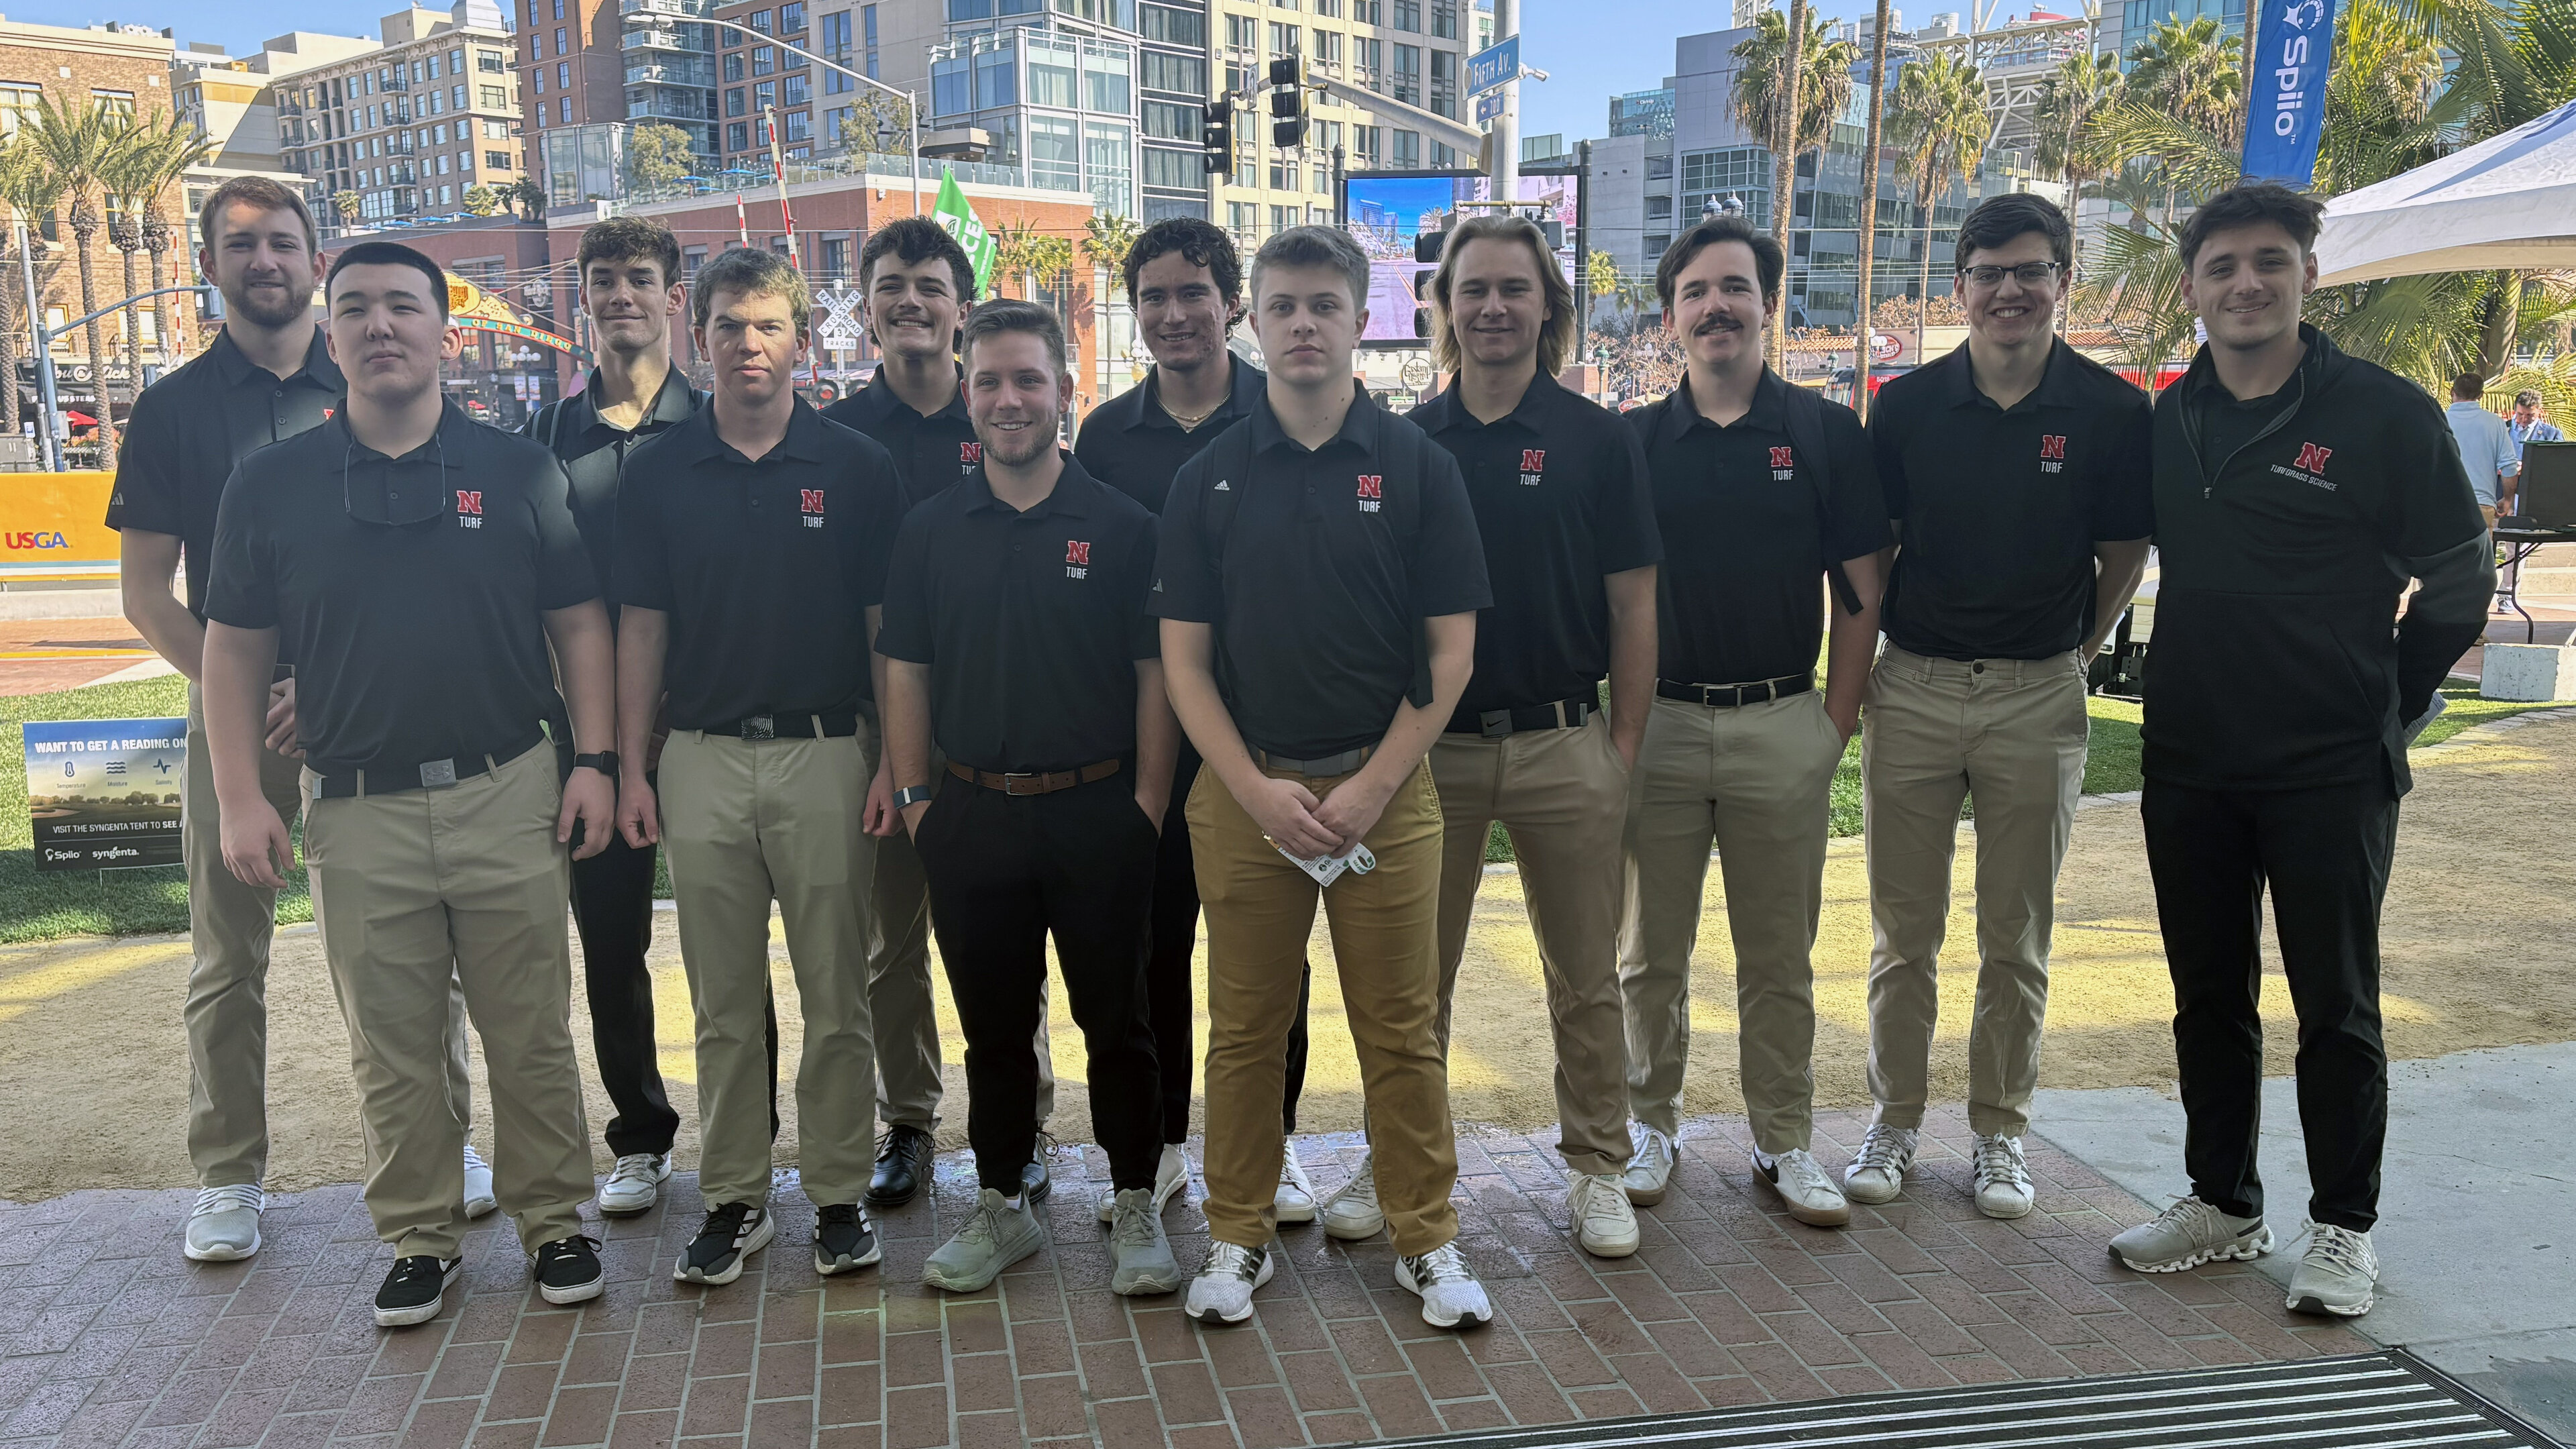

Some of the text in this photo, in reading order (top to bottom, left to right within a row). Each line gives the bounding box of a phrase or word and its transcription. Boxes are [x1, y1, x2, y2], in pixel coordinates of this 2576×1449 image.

[1474, 59, 1495, 86] FIFTH
[2275, 35, 2308, 136] Spiio
[496, 322, 521, 334] SAN
[531, 330, 572, 351] DIEGO
[837, 327, 842, 337] 3
[960, 442, 981, 463] N
[1770, 446, 1792, 467] N
[2041, 435, 2066, 458] N
[1520, 449, 1545, 472] N
[2041, 461, 2063, 474] TURF
[2294, 441, 2332, 474] N
[1519, 474, 1541, 486] TURF
[1772, 470, 1793, 481] TURF
[2270, 464, 2338, 492] TURFGRASS SCIENCE
[1357, 475, 1382, 498] N
[456, 490, 482, 515] N
[800, 489, 824, 513] N
[1358, 500, 1381, 513] TURF
[458, 516, 482, 529] TURF
[802, 516, 824, 528] TURF
[5, 531, 69, 549] USGA
[1066, 540, 1090, 565] N
[1066, 566, 1087, 580] TURF
[35, 741, 67, 753] WANT
[70, 741, 85, 752] TO
[87, 740, 107, 751] GET
[111, 739, 119, 751] A
[122, 739, 170, 750] READING
[53, 825, 72, 834] VISIT
[72, 824, 88, 833] THE
[89, 822, 128, 833] SYNGENTA
[129, 822, 149, 830] TENT
[150, 821, 160, 829] TO
[162, 820, 178, 828] SEE
